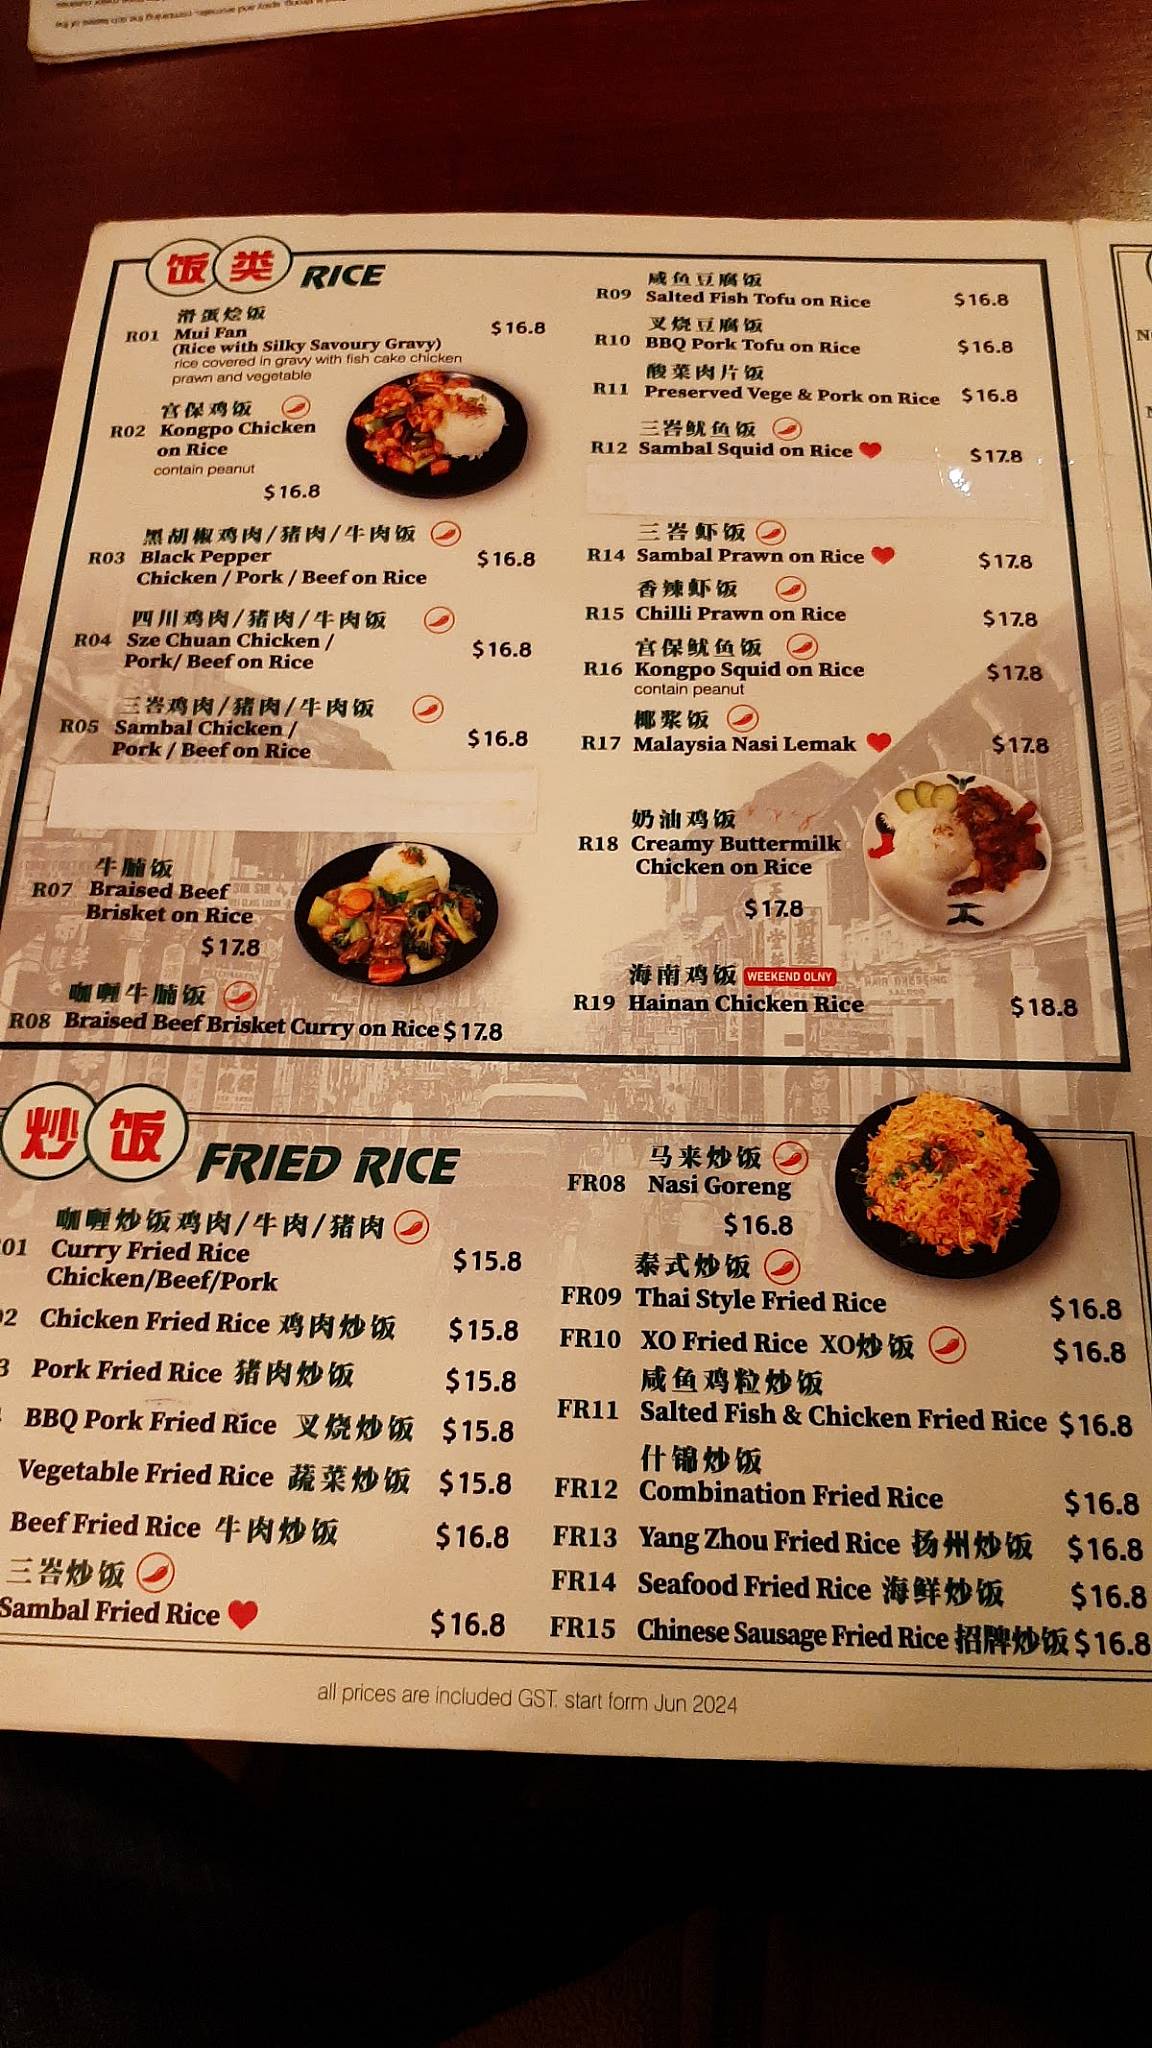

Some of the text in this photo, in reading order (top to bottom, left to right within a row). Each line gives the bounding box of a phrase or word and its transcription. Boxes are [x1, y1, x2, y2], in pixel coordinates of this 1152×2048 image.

[301, 265, 385, 289] RICE
[126, 327, 246, 342] R01 Mui Fan
[173, 338, 441, 356] (Rice with Silky Savoury Gravy)
[175, 359, 198, 368] rice
[202, 357, 255, 368] covered
[275, 357, 311, 368] gravy
[316, 355, 341, 364] with
[347, 354, 369, 363] fish
[374, 353, 405, 363] cake
[411, 353, 461, 363] chicken
[172, 370, 311, 386] prawn and vegetable
[594, 383, 626, 394] R11
[645, 385, 742, 399] Preserved
[747, 387, 792, 403] Vege
[818, 389, 863, 402] Pork
[869, 394, 892, 403] on
[898, 392, 940, 405] Rice
[111, 420, 315, 439] R02 Kongpo Chicken
[157, 442, 227, 456] on Rice
[154, 465, 254, 477] contain peanut
[89, 550, 272, 566] R03 Black Pepper
[588, 548, 864, 563] R14 Sambal Prawn on Rice
[137, 570, 216, 585] Chicken
[236, 570, 283, 584] Pork
[303, 570, 349, 584] Beef
[352, 574, 376, 584] on
[383, 570, 426, 584] Rice
[635, 684, 744, 698] contain peanut
[582, 736, 856, 755] R17 Malaysia Nasi Lemak
[579, 835, 841, 856] R18 Creamy Buttermilk
[636, 858, 812, 875] Chicken on Rice
[32, 882, 73, 897] R07
[89, 881, 173, 899] Braised
[179, 884, 231, 899] Beef
[86, 904, 253, 924] Brisket on Rice
[747, 970, 832, 982] WEEKEND OLNY
[574, 994, 864, 1013] R19 Hainan Chicken Rice
[197, 1143, 341, 1184] FRIED
[353, 1147, 460, 1188] RICE
[650, 1145, 761, 1169] 马来炒饭
[568, 1174, 791, 1201] FR08 Nasi Goreng
[52, 1239, 249, 1264] Curry Fried Rice
[635, 1252, 750, 1278] 泰式炒饭
[47, 1266, 278, 1293] Chicken/Beef/Pork
[561, 1286, 886, 1314] FR09 Thai Style Fried Rice
[560, 1329, 621, 1348] FR10
[641, 1331, 676, 1350] XO
[683, 1330, 747, 1352] Fried
[754, 1332, 807, 1353] Rice
[32, 1359, 90, 1379] Pork
[96, 1360, 162, 1381] Fried
[168, 1361, 222, 1383] Rice
[235, 1359, 354, 1387] 猪肉炒饭
[19, 1459, 410, 1494] Vegetable Fried Rice 蔬菜炒饭
[0, 1597, 220, 1625] Sambal Fried Rice
[550, 1616, 615, 1639] FR15
[638, 1618, 729, 1643] Chinese
[734, 1622, 827, 1652] Sausage
[832, 1624, 893, 1648] Fried
[898, 1625, 949, 1649] Rice
[954, 1624, 1069, 1656] 招牌炒饭
[318, 1683, 737, 1713] all prices are included GST. start form Jun 2024
